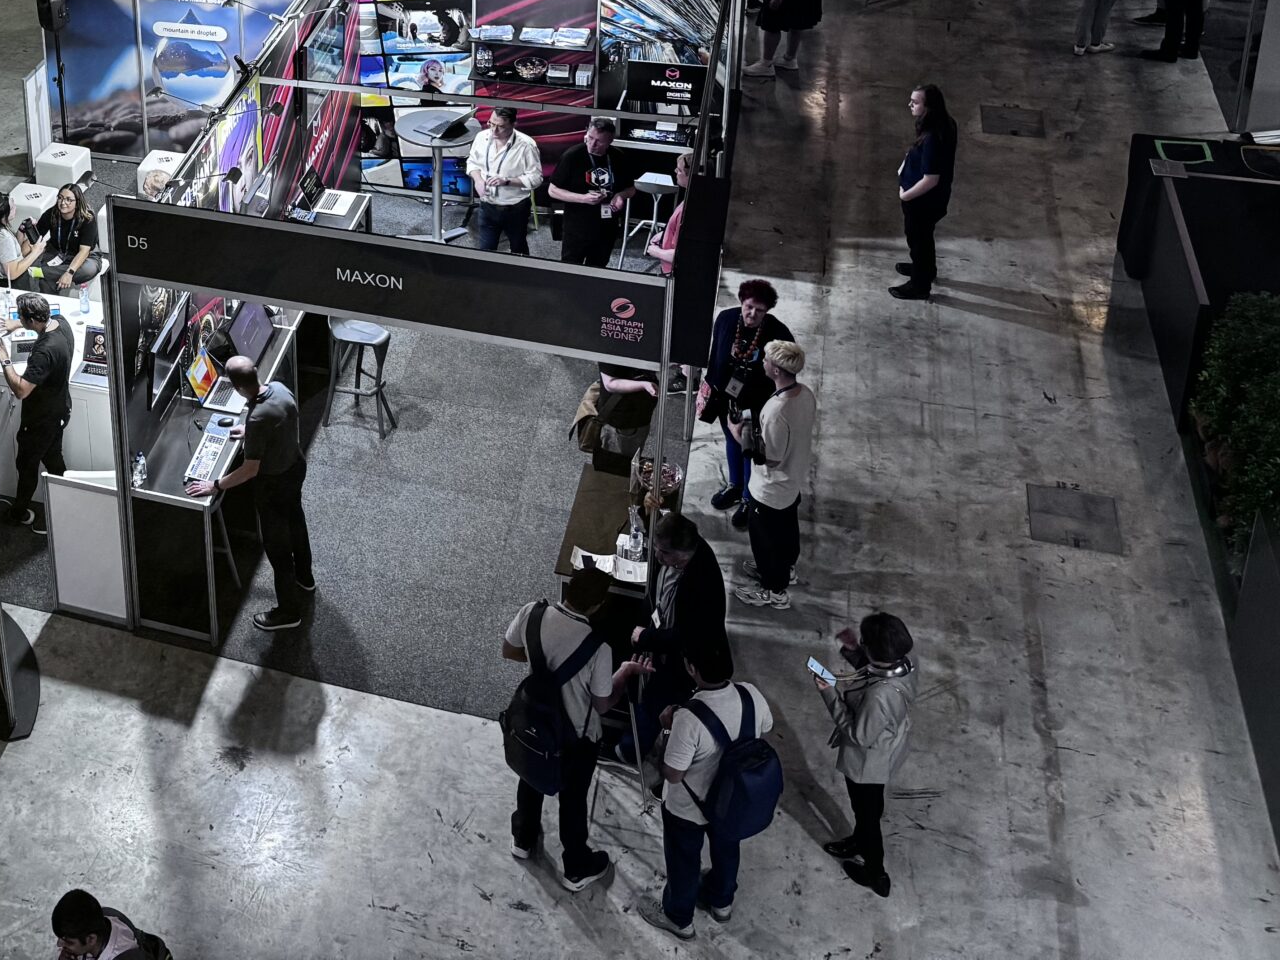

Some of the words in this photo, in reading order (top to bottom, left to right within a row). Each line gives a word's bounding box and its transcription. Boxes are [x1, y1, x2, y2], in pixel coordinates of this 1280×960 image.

[162, 26, 189, 34] mountain
[196, 26, 217, 37] droplet
[651, 80, 692, 90] MAXON
[127, 235, 148, 250] D5
[335, 267, 404, 291] MAXON
[601, 317, 644, 328] SIGGRAPH
[601, 324, 621, 332] ASIA
[624, 326, 644, 335] 2023
[600, 329, 643, 342] SYDNEY
